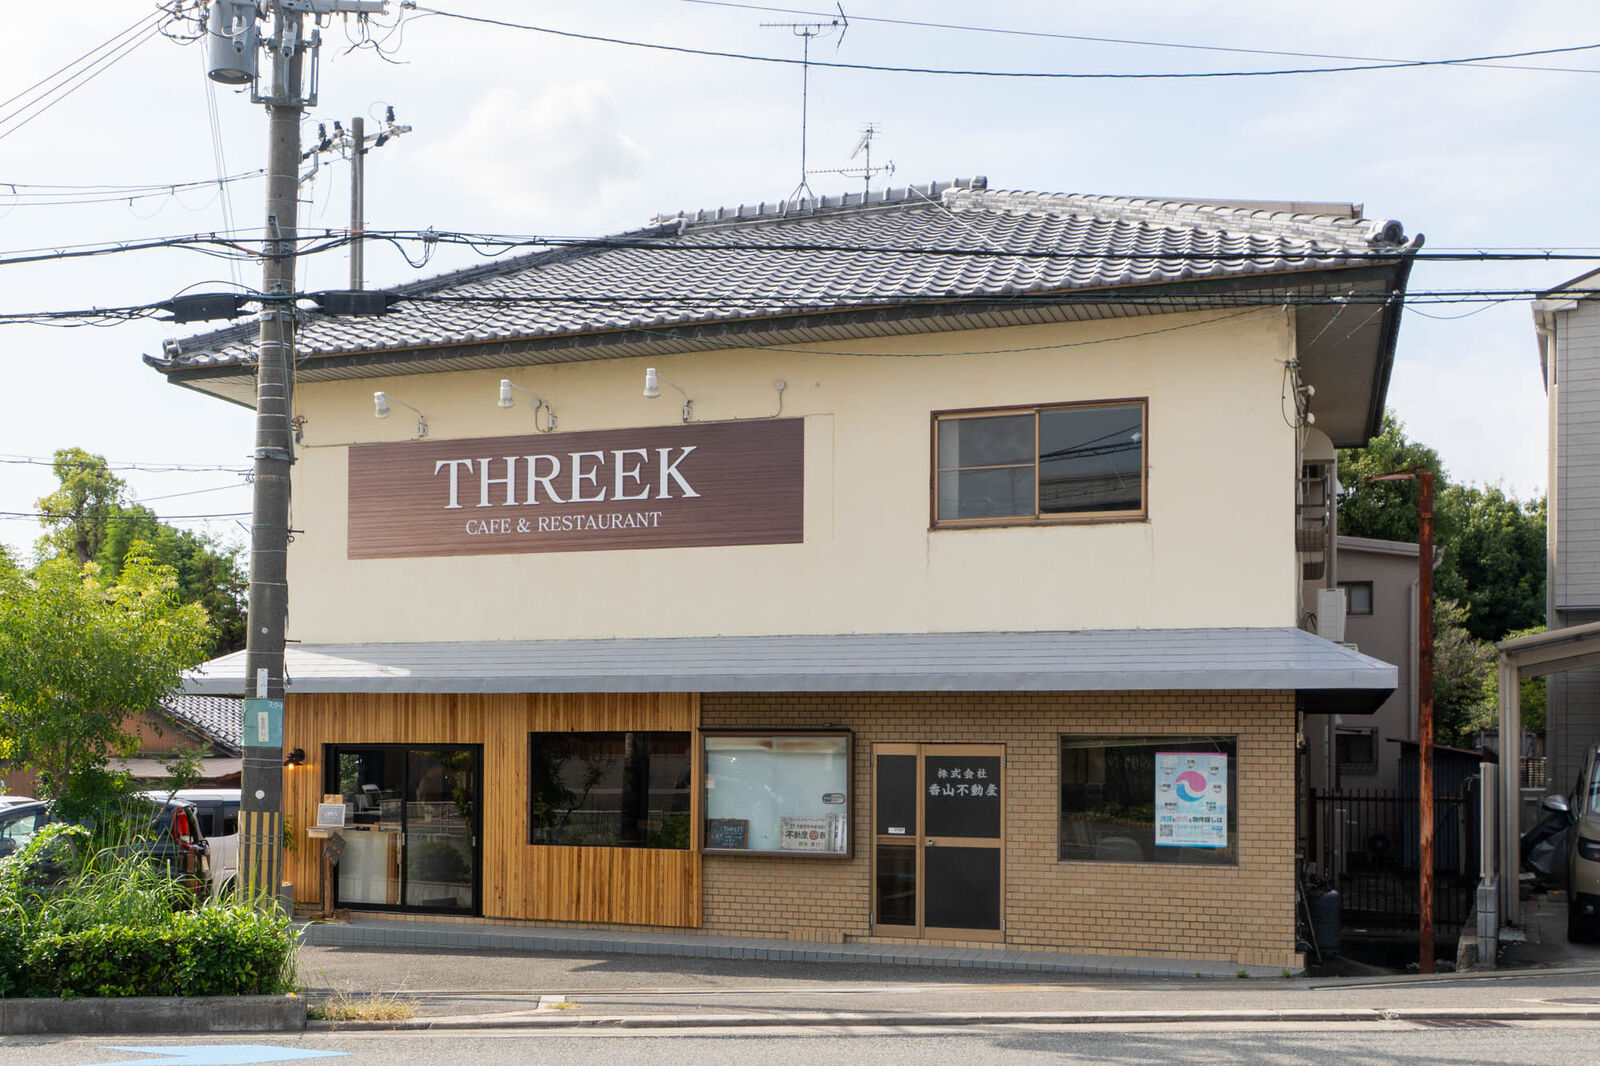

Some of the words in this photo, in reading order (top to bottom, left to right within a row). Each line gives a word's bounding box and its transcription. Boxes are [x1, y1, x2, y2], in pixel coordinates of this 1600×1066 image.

[433, 446, 701, 509] THREEK
[465, 518, 511, 535] CAFE
[516, 517, 531, 533] &
[538, 511, 662, 532] RESTAURANT
[937, 768, 988, 779] 株式会社
[928, 783, 998, 797] 香山不動産
